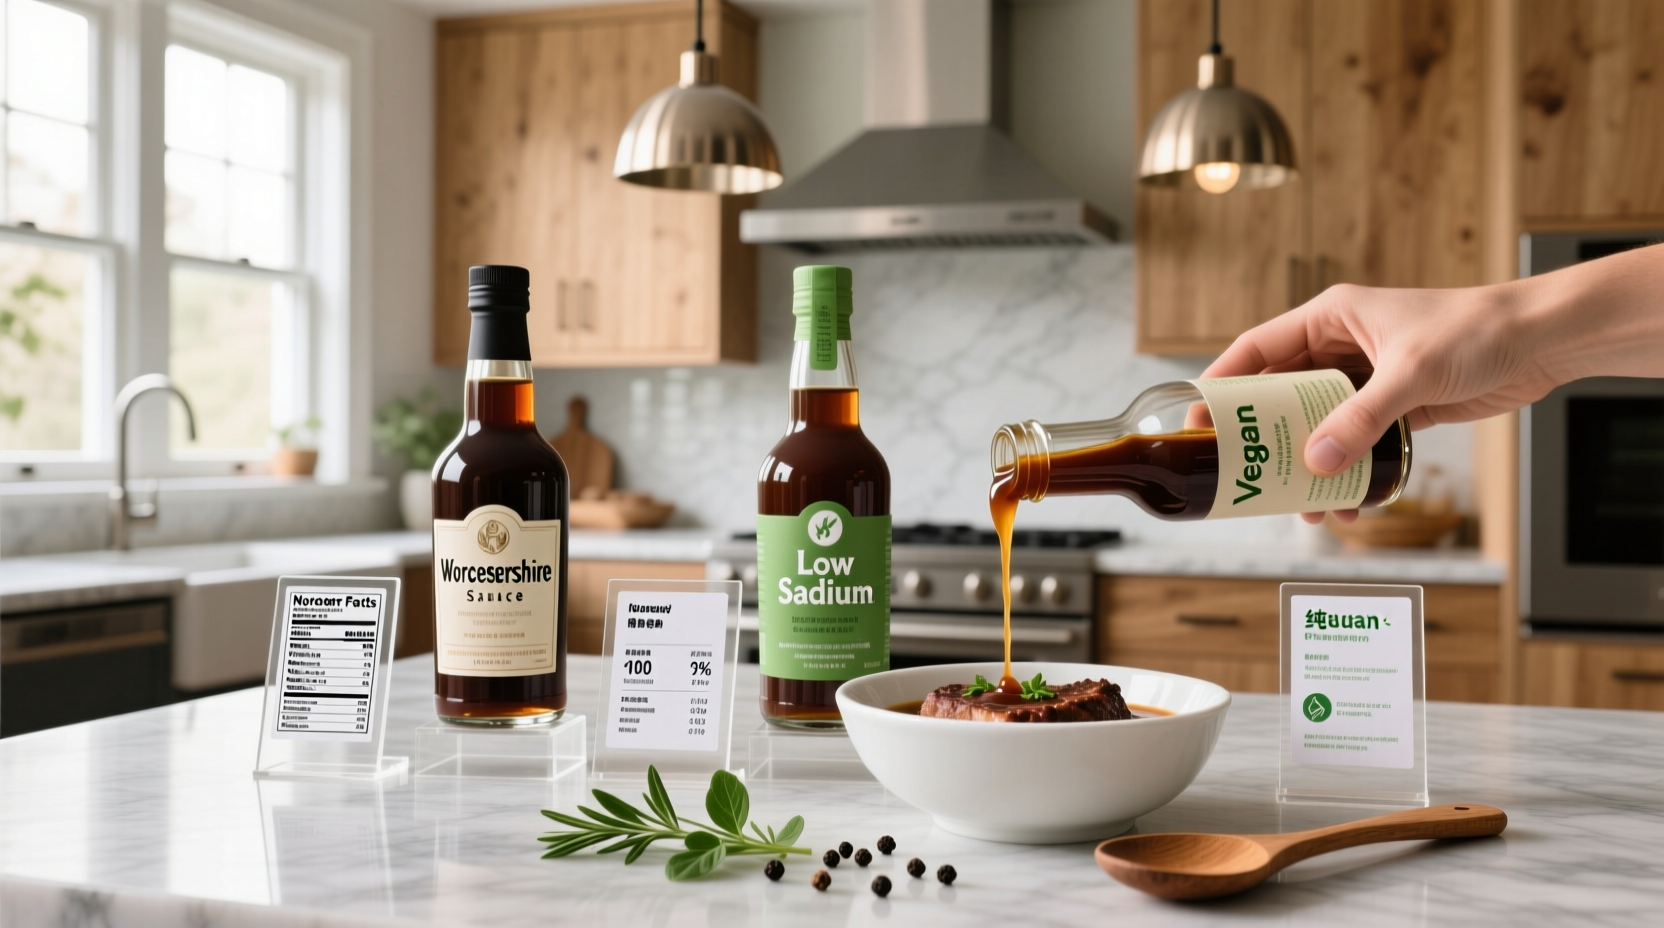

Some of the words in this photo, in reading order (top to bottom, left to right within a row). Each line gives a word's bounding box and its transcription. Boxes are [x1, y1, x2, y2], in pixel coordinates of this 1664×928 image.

[1232, 404, 1270, 505] Vegan
[441, 558, 552, 583] Worcesershire
[797, 549, 855, 576] Low
[778, 577, 874, 605] Sadium
[623, 659, 652, 675] 100
